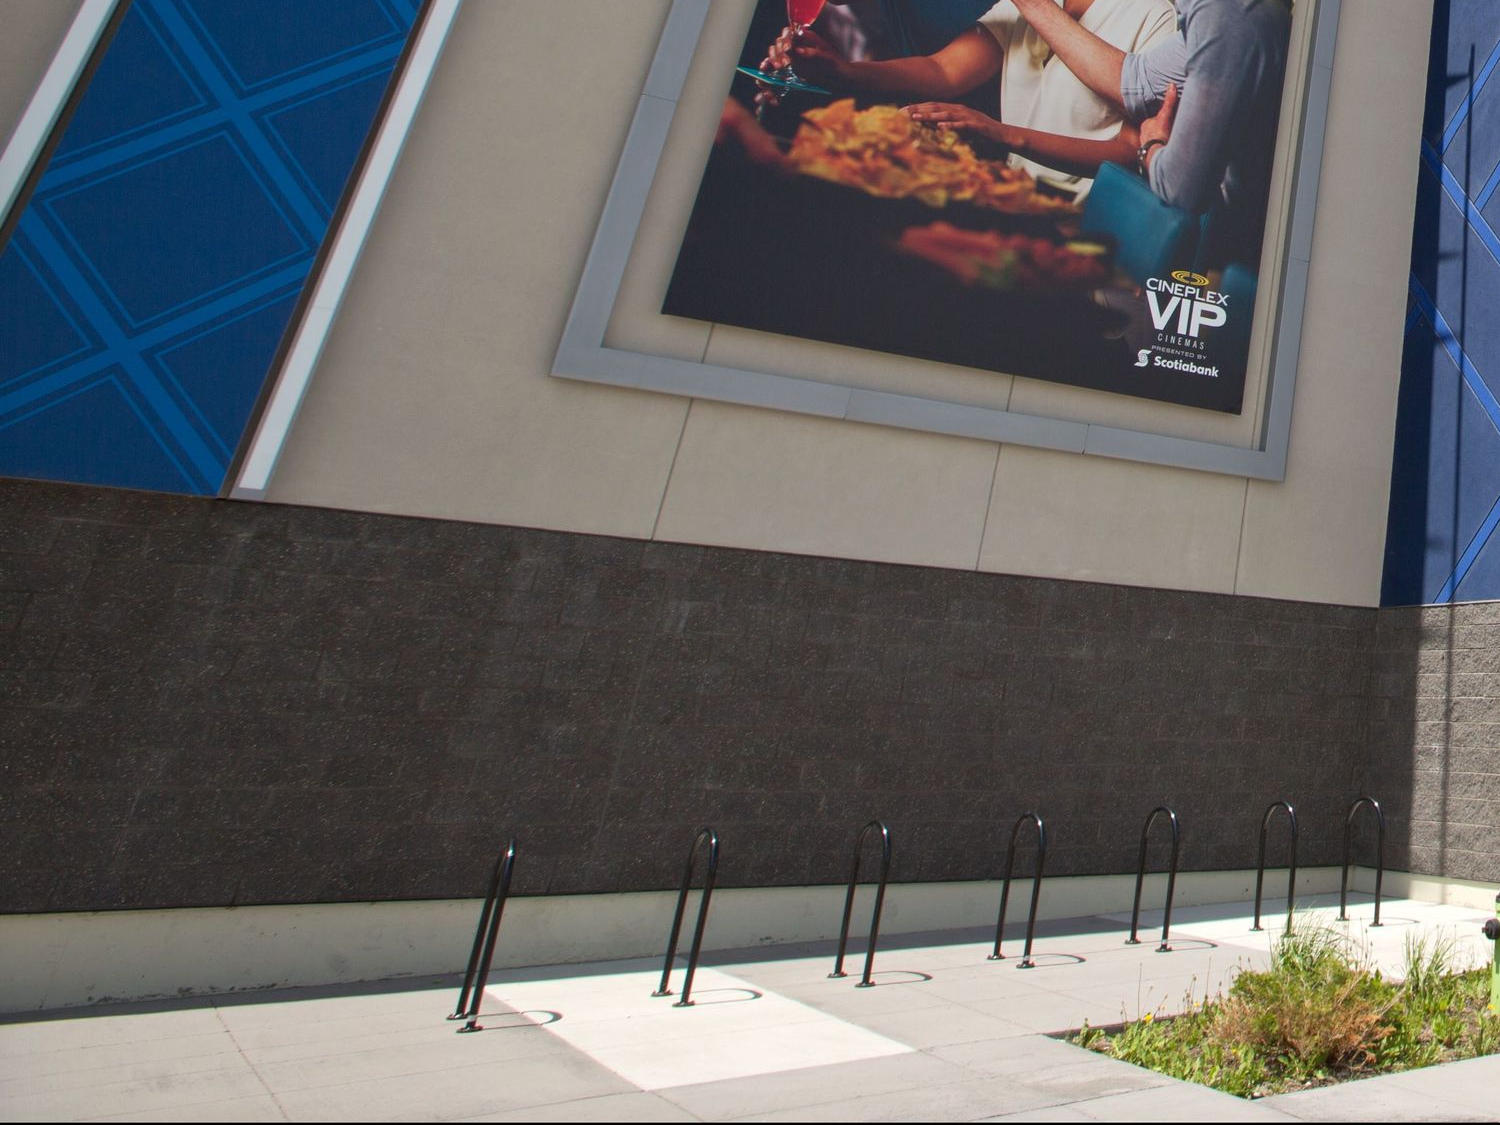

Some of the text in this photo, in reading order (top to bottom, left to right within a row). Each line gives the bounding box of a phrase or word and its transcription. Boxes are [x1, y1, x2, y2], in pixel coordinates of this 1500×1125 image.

[1146, 277, 1230, 306] CINEPLEX
[1146, 290, 1227, 337] VIP
[1151, 345, 1195, 358] PRESENTED
[1157, 333, 1205, 350] CINEMAS
[1154, 356, 1219, 377] Scotiabank
